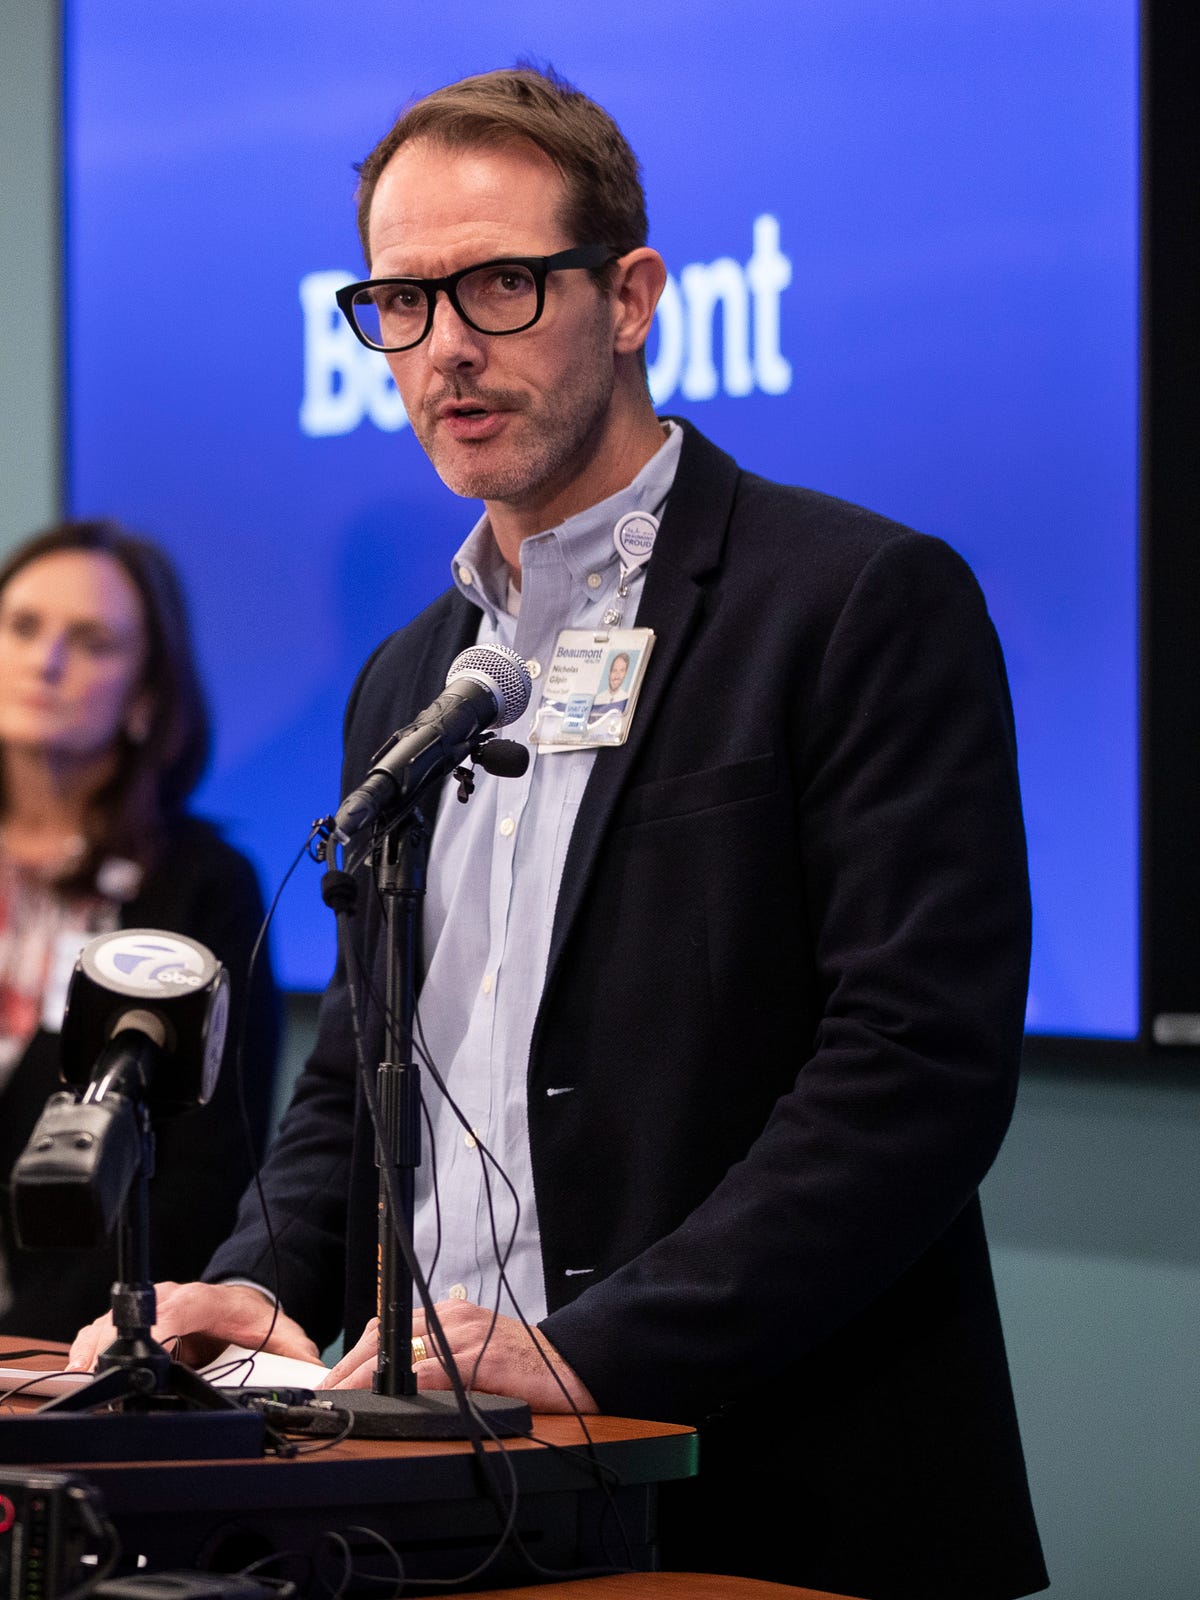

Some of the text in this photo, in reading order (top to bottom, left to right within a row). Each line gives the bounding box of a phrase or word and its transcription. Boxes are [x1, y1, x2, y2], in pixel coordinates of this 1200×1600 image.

[624, 538, 652, 548] PROUD
[556, 646, 603, 659] Beaumont
[552, 665, 579, 673] Nicholas
[157, 968, 202, 987] abc
